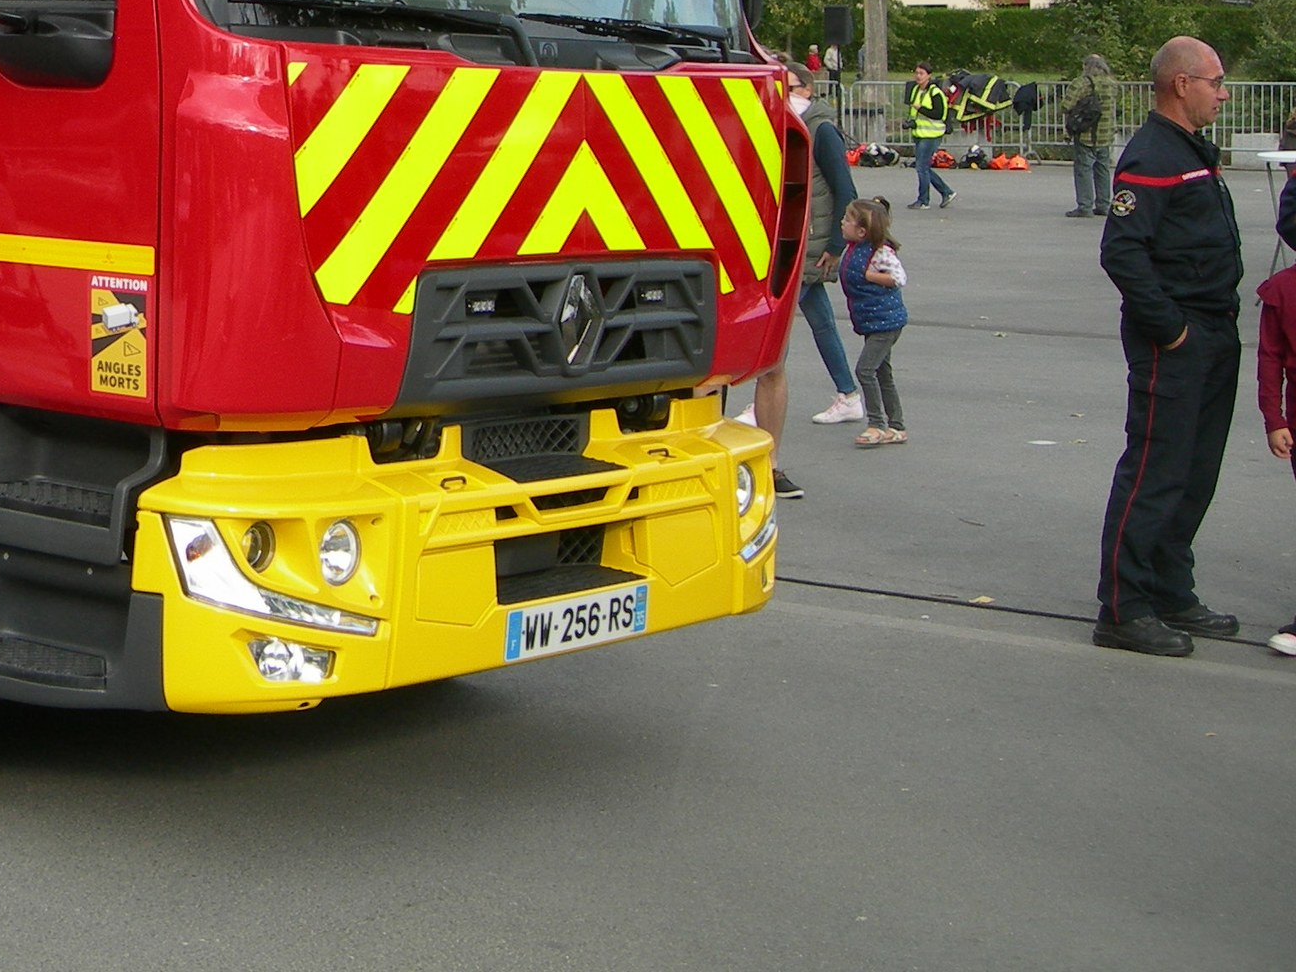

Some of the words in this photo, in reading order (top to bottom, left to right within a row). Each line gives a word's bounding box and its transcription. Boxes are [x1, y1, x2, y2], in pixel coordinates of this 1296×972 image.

[91, 275, 148, 291] ATTENTION
[97, 360, 142, 377] ANGLES
[99, 375, 140, 391] MORTS
